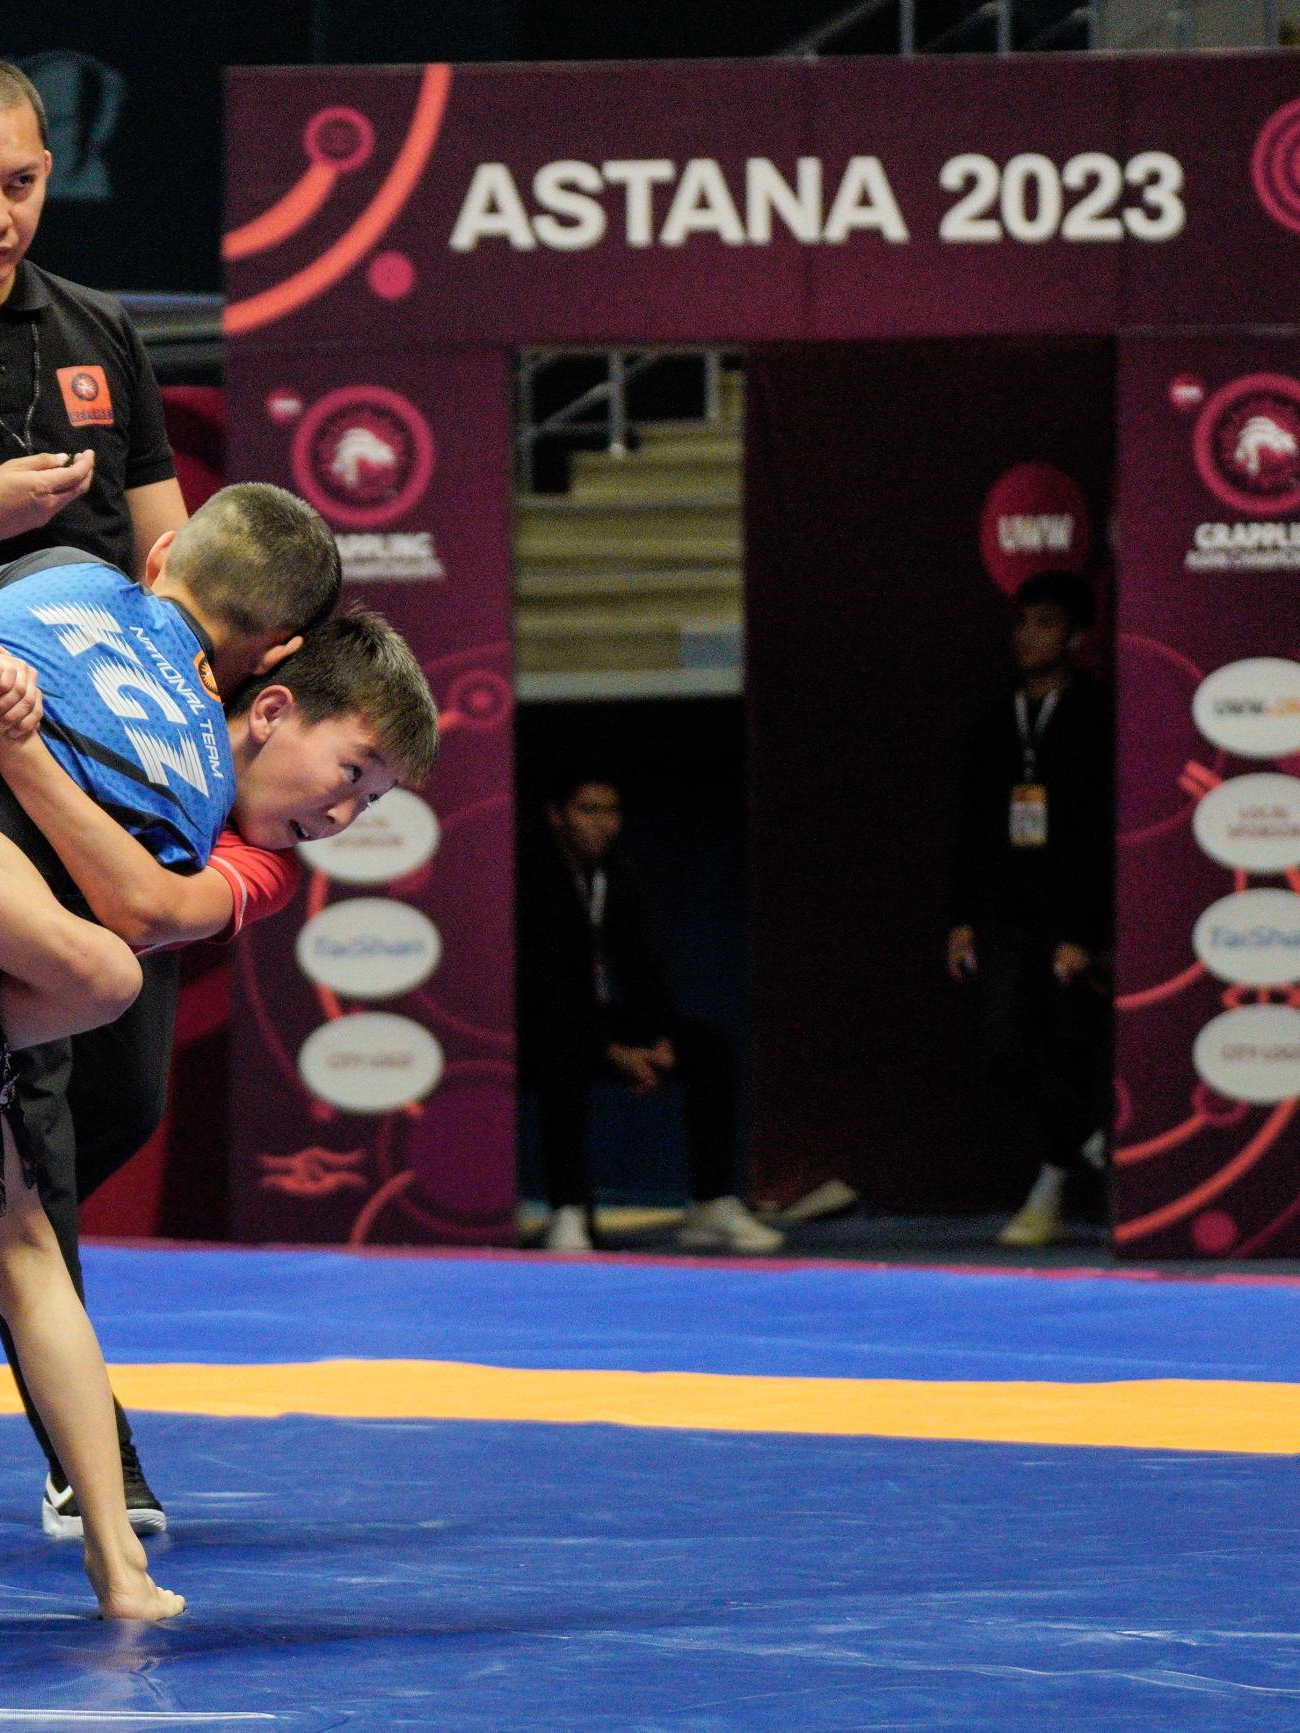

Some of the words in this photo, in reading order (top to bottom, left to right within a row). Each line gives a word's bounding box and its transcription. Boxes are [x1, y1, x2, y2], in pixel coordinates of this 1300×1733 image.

[449, 156, 909, 250] ASTANA
[939, 152, 1185, 243] 2023
[27, 600, 209, 798] KGZ
[129, 625, 208, 716] NATIONAL
[199, 718, 226, 779] TEAM
